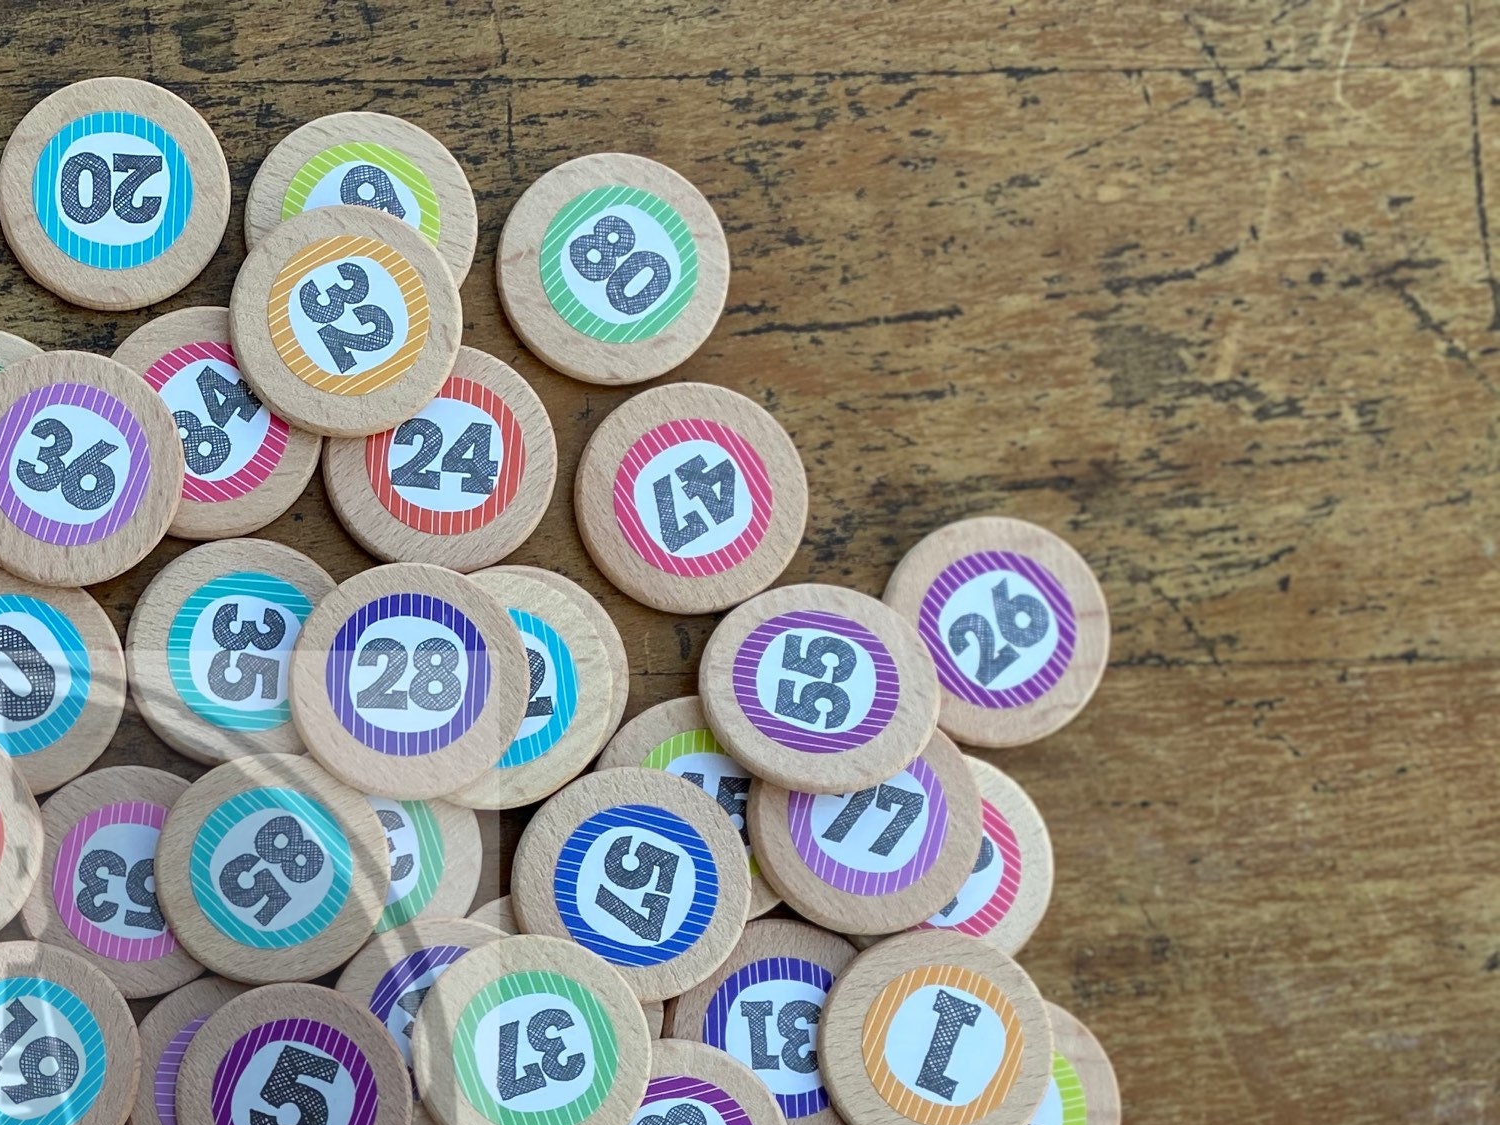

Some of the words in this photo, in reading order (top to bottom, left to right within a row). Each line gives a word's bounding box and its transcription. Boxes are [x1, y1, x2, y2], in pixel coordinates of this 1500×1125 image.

[62, 152, 164, 226] 20
[570, 219, 673, 316] 80
[300, 263, 395, 375] 32
[17, 419, 118, 512] 36
[173, 366, 264, 476] 84
[391, 418, 500, 496] 24
[654, 457, 737, 552] 47
[209, 604, 288, 703] 35
[361, 638, 462, 712] 28
[774, 623, 859, 730] 55
[948, 577, 1052, 687] 26
[77, 839, 167, 933] 53
[219, 816, 326, 928] 85
[596, 836, 681, 943] 57
[499, 1010, 587, 1102] 37
[742, 1002, 826, 1086] 31
[917, 990, 983, 1102] 1
